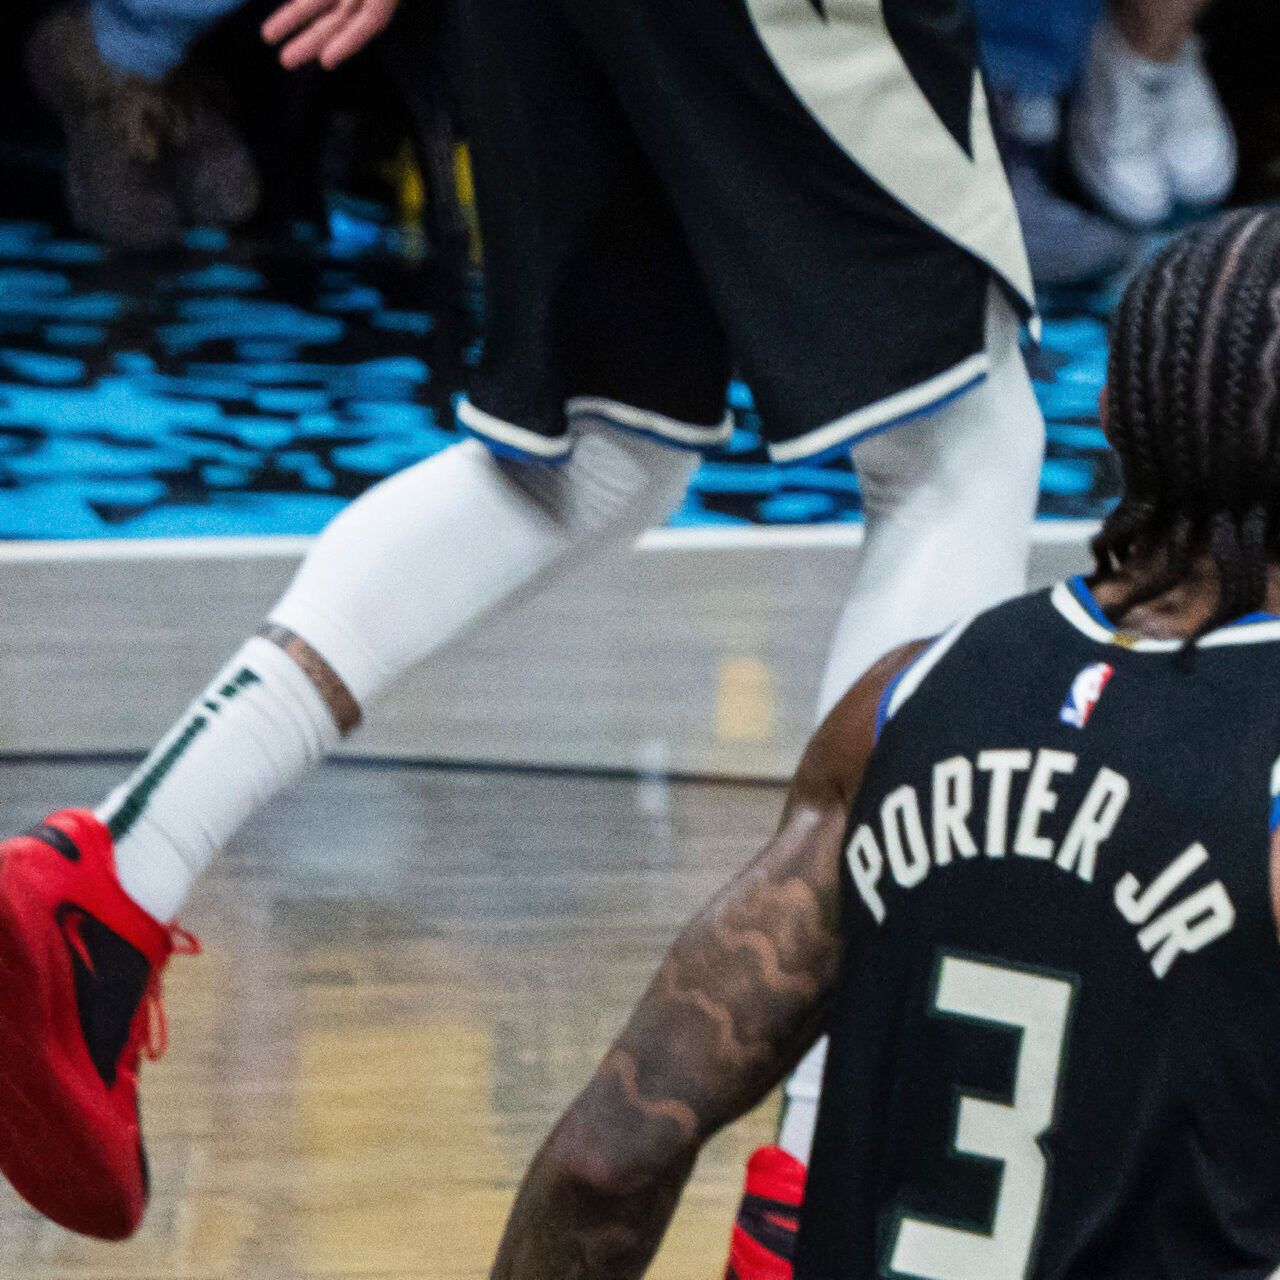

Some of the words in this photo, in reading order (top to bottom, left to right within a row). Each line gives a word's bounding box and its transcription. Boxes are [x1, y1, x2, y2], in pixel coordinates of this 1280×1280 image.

[846, 748, 1130, 926] PORTER
[1114, 841, 1237, 980] JR
[884, 953, 1077, 1280] 3
